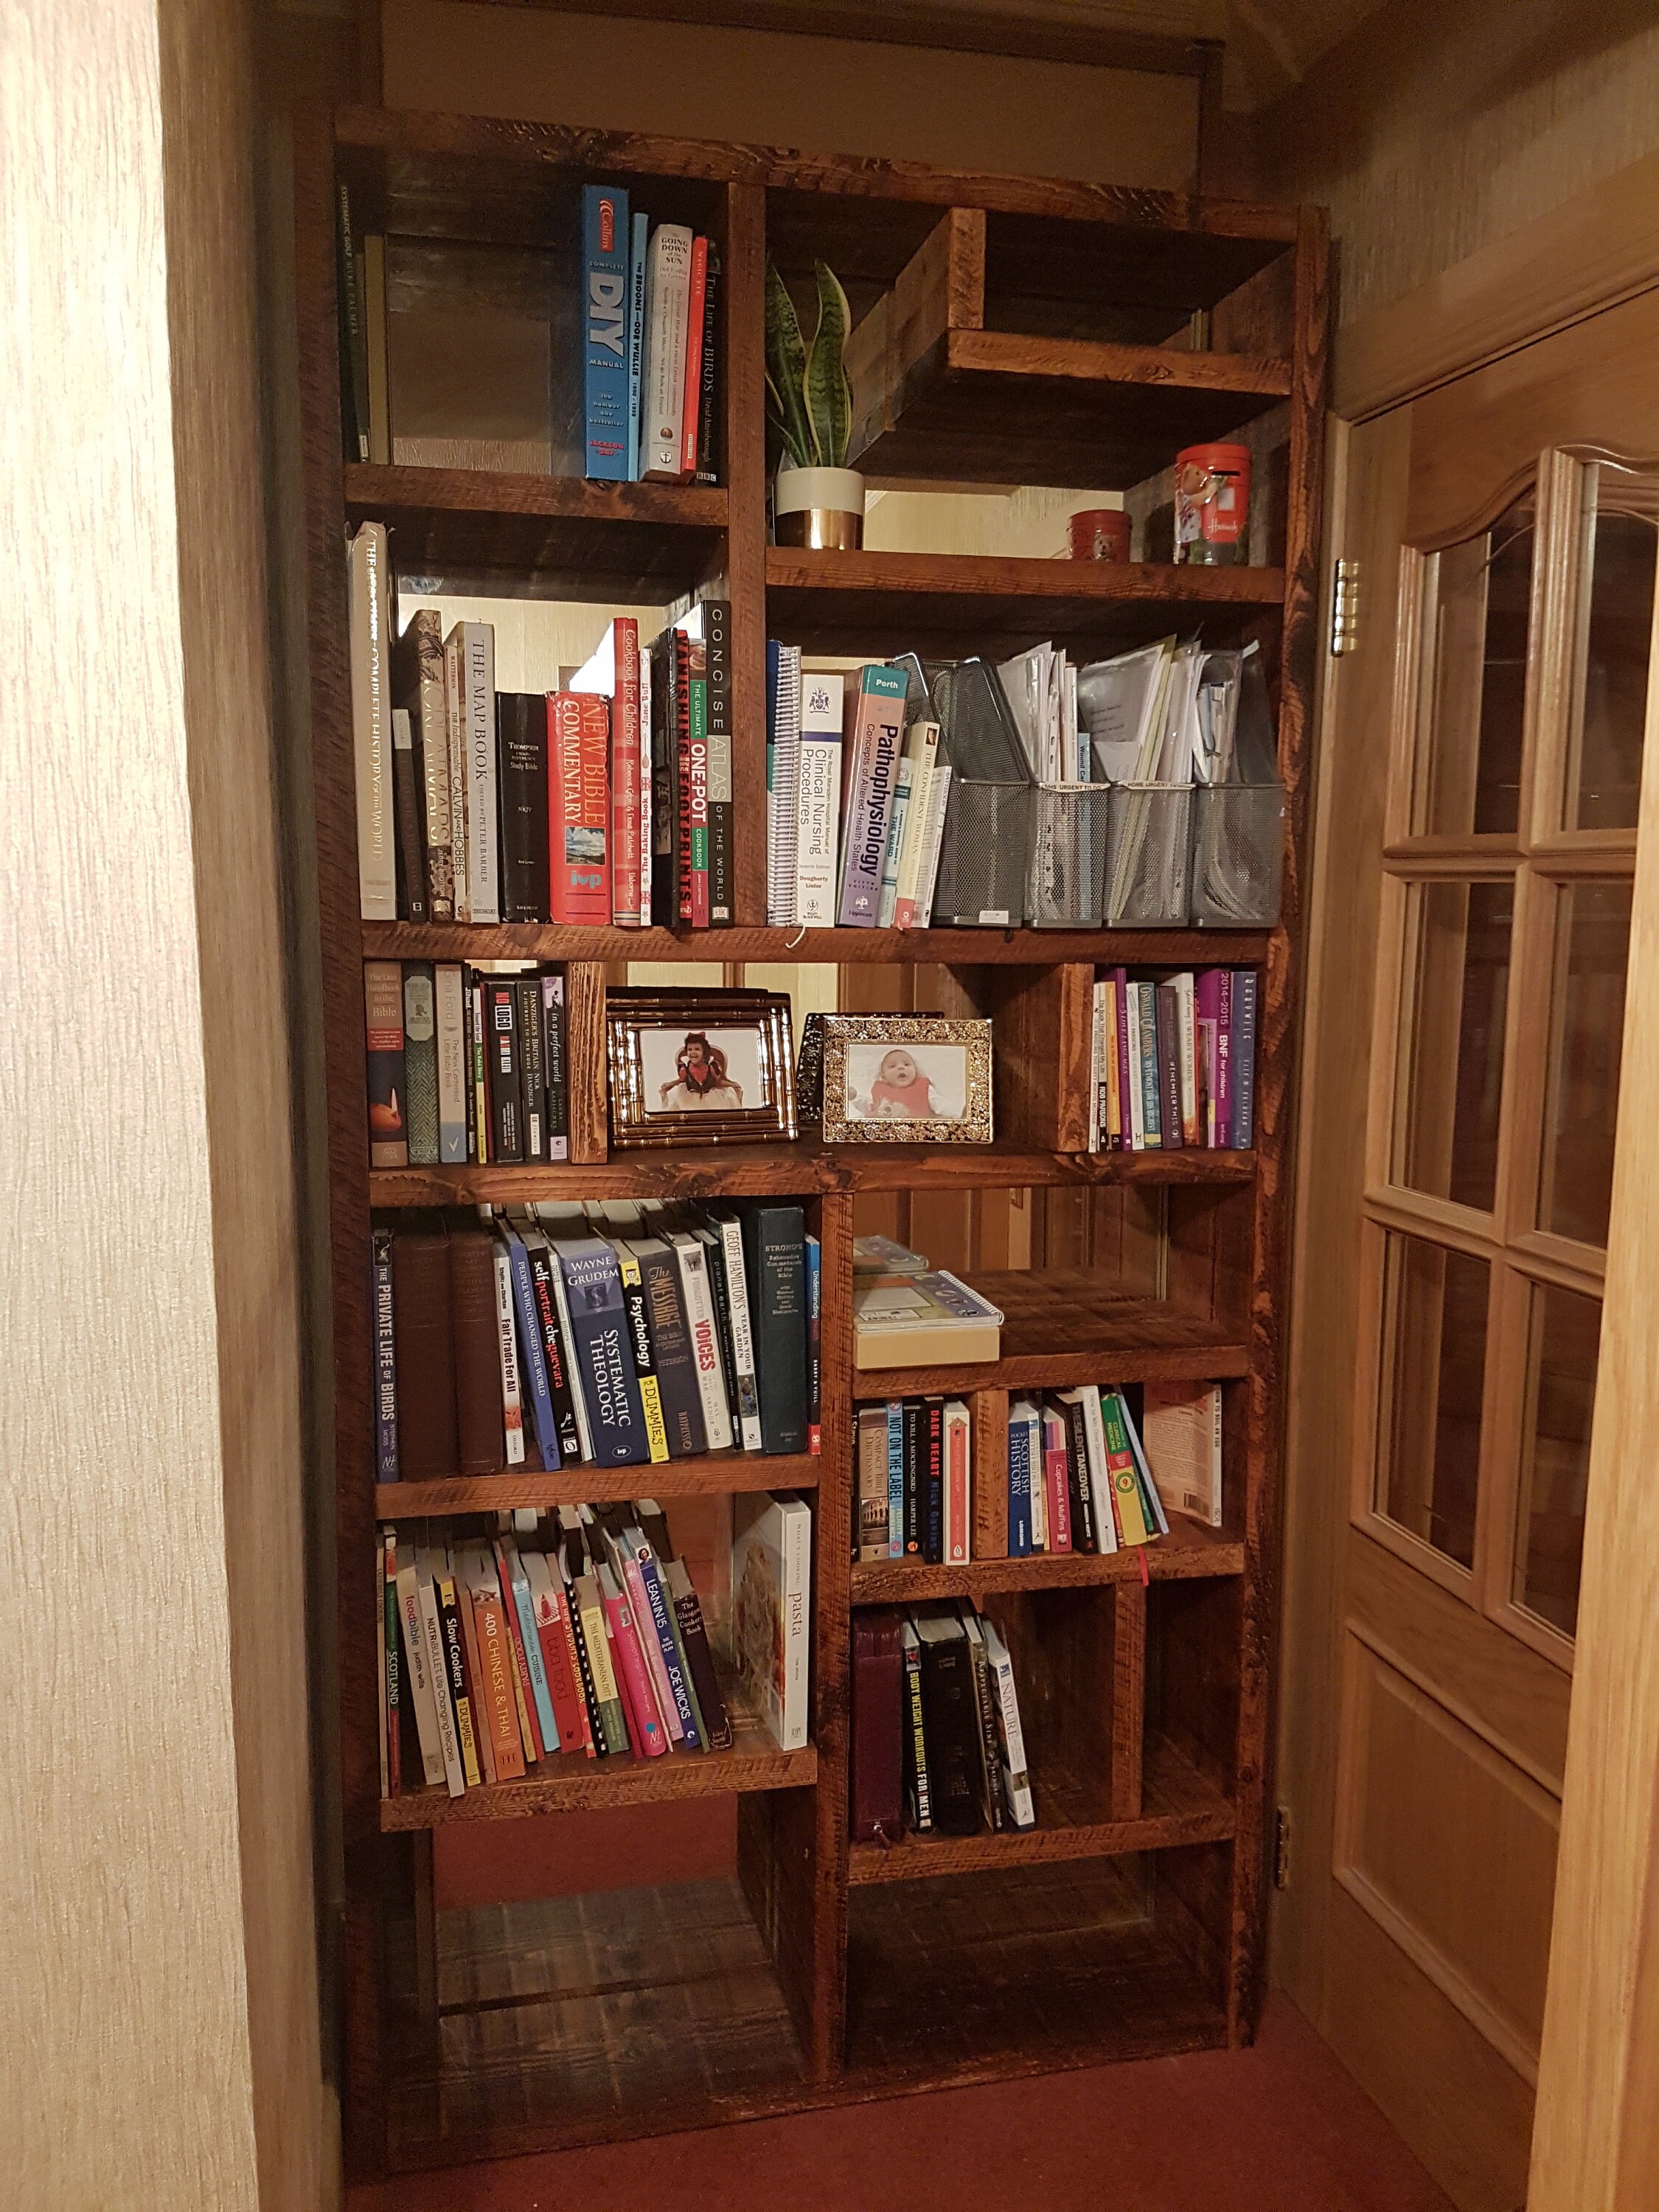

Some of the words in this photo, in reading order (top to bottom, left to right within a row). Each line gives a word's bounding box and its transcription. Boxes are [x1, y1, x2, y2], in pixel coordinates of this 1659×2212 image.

[601, 212, 613, 249] Collins
[661, 237, 688, 246] GOING
[661, 245, 688, 254] DOWN
[666, 257, 683, 265] SUN
[589, 260, 625, 271] COMPLETE
[706, 276, 716, 299] THE
[589, 272, 625, 358] DIY
[706, 305, 715, 327] LIFE
[705, 330, 713, 343] OF
[589, 358, 625, 369] MANUAL
[703, 349, 714, 392] BIRDS
[1207, 518, 1239, 533] Harrods
[473, 640, 485, 678] THE
[625, 630, 636, 681] Cookbook
[712, 608, 724, 729] CONCISE
[623, 681, 636, 702] for
[875, 679, 898, 689] Porth
[474, 685, 487, 723] MAP
[582, 701, 607, 758] NEW
[626, 703, 637, 745] Children
[451, 724, 462, 772] Indispensable
[474, 729, 487, 781] BOOK
[508, 742, 540, 751] THOMPSON
[862, 723, 875, 765] Concepts
[509, 761, 524, 771] Study
[525, 762, 538, 771] Bible
[563, 700, 581, 824] COMMENTARY
[711, 737, 727, 800] ATLAS
[813, 749, 827, 793] Clinical
[862, 768, 869, 778] of
[583, 763, 606, 825] BIBLE
[691, 743, 706, 823] ONE-POT
[800, 749, 814, 825] Procedures
[858, 779, 869, 810] Altered
[452, 776, 463, 820] CALVIN
[859, 724, 899, 877] Pathophysiology
[716, 805, 723, 821] OF
[854, 813, 865, 841] Health
[890, 815, 898, 832] THE
[641, 823, 650, 858] Baking
[809, 802, 825, 855] Nursing
[454, 831, 465, 876] HOBBES
[851, 844, 861, 872] States
[887, 833, 897, 857] WARD
[848, 909, 873, 918] Lippincott
[372, 1007, 397, 1018] Bible
[496, 1006, 512, 1030] LOGO
[529, 990, 538, 1037] DANZIGER'S
[551, 1012, 557, 1022] in
[531, 1038, 540, 1069] BRITAIN
[550, 1032, 562, 1058] perfect
[533, 1073, 541, 1090] NICK
[553, 1059, 562, 1083] world
[526, 1074, 535, 1107] DANZIGER
[726, 1230, 739, 1257] GEOFF
[378, 1267, 388, 1282] THE
[518, 1261, 529, 1290] PEOPLE
[568, 1269, 619, 1286] GRUDEM
[570, 1256, 612, 1273] WAYNE
[712, 1261, 723, 1293] planet
[728, 1259, 746, 1310] HAMILTON'S
[378, 1284, 393, 1337] PRIVATE
[524, 1291, 532, 1311] WHO
[649, 1276, 683, 1330] MESSAGE
[717, 1295, 728, 1322] earth
[501, 1318, 511, 1336] Fair
[526, 1311, 539, 1346] CHANGED
[630, 1296, 650, 1368] Psychology
[740, 1313, 749, 1335] YEAR
[380, 1340, 393, 1368] LIFE
[502, 1336, 514, 1364] Trade
[735, 1326, 744, 1359] GARDEN
[743, 1336, 750, 1345] IN
[532, 1347, 542, 1366] THE
[383, 1370, 392, 1380] OF
[504, 1365, 515, 1380] For
[535, 1366, 546, 1397] WORLD
[590, 1335, 616, 1426] THEOLOGY
[604, 1329, 631, 1428] SYSTEMATIC
[507, 1381, 517, 1393] All
[380, 1382, 395, 1422] BIRDS
[644, 1388, 664, 1447] DUMMIES
[889, 1416, 902, 1435] NOT
[930, 1409, 940, 1438] DARK
[889, 1437, 902, 1450] ON
[865, 1436, 874, 1489] DICTIONARY
[889, 1452, 902, 1472] THE
[930, 1442, 940, 1476] HEART
[1011, 1439, 1022, 1496] HISTORY
[1020, 1438, 1030, 1494] SCOTTISH
[889, 1474, 902, 1501] LABEL
[1054, 1463, 1064, 1499] Cupcakes
[1057, 1506, 1066, 1531] Muffins
[646, 1579, 660, 1607] LEAN
[681, 1601, 695, 1610] The
[484, 1612, 497, 1637] 400
[654, 1604, 664, 1618] IN
[656, 1616, 667, 1629] 15
[787, 1592, 803, 1637] pasta
[446, 1617, 458, 1644] Slow
[686, 1624, 701, 1635] Book
[413, 1652, 423, 1672] judith
[515, 1637, 525, 1660] FOOD
[547, 1635, 560, 1667] bbq
[389, 1651, 400, 1705] SCOTLAND
[450, 1645, 464, 1688] Cookers
[488, 1638, 505, 1691] CHINESE
[518, 1661, 530, 1686] PARTY
[417, 1673, 425, 1689] wills
[553, 1668, 569, 1700] food
[668, 1664, 679, 1686] JOE
[674, 1685, 691, 1719] WICKS
[909, 1672, 920, 1694] BODY
[495, 1695, 507, 1706] &
[911, 1695, 923, 1727] WEIGHT
[1001, 1683, 1018, 1740] NATURE
[459, 1707, 473, 1749] DUMMIES
[497, 1708, 511, 1737] THAI
[913, 1726, 927, 1773] WORKOUTS
[917, 1773, 928, 1792] FOR
[919, 1795, 931, 1822] MEN
